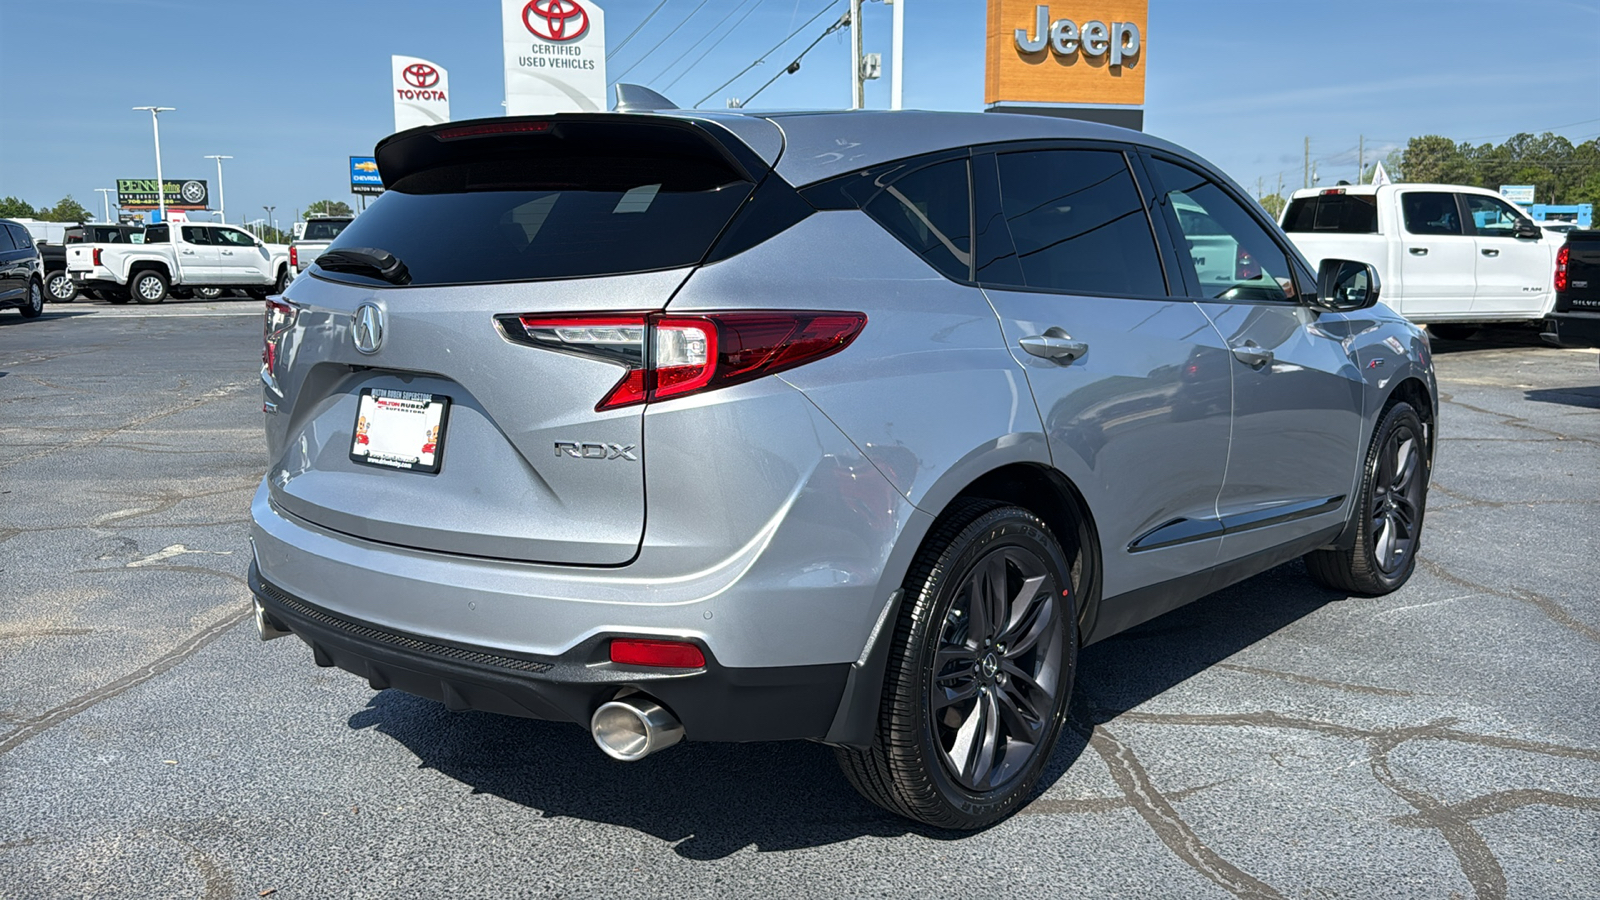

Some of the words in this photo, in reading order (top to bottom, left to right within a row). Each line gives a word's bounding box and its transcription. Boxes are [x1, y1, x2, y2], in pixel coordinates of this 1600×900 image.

[1014, 5, 1140, 67] Jeep
[531, 43, 582, 56] CERTIFIED
[518, 56, 546, 67] USED
[548, 57, 595, 70] VEHICLES
[396, 89, 447, 102] TOYOTA
[119, 180, 156, 191] PENN
[156, 182, 180, 193] Rofing
[388, 390, 402, 398] RUBEN
[403, 392, 432, 400] SUPERSTORE
[554, 440, 638, 461] RDX
